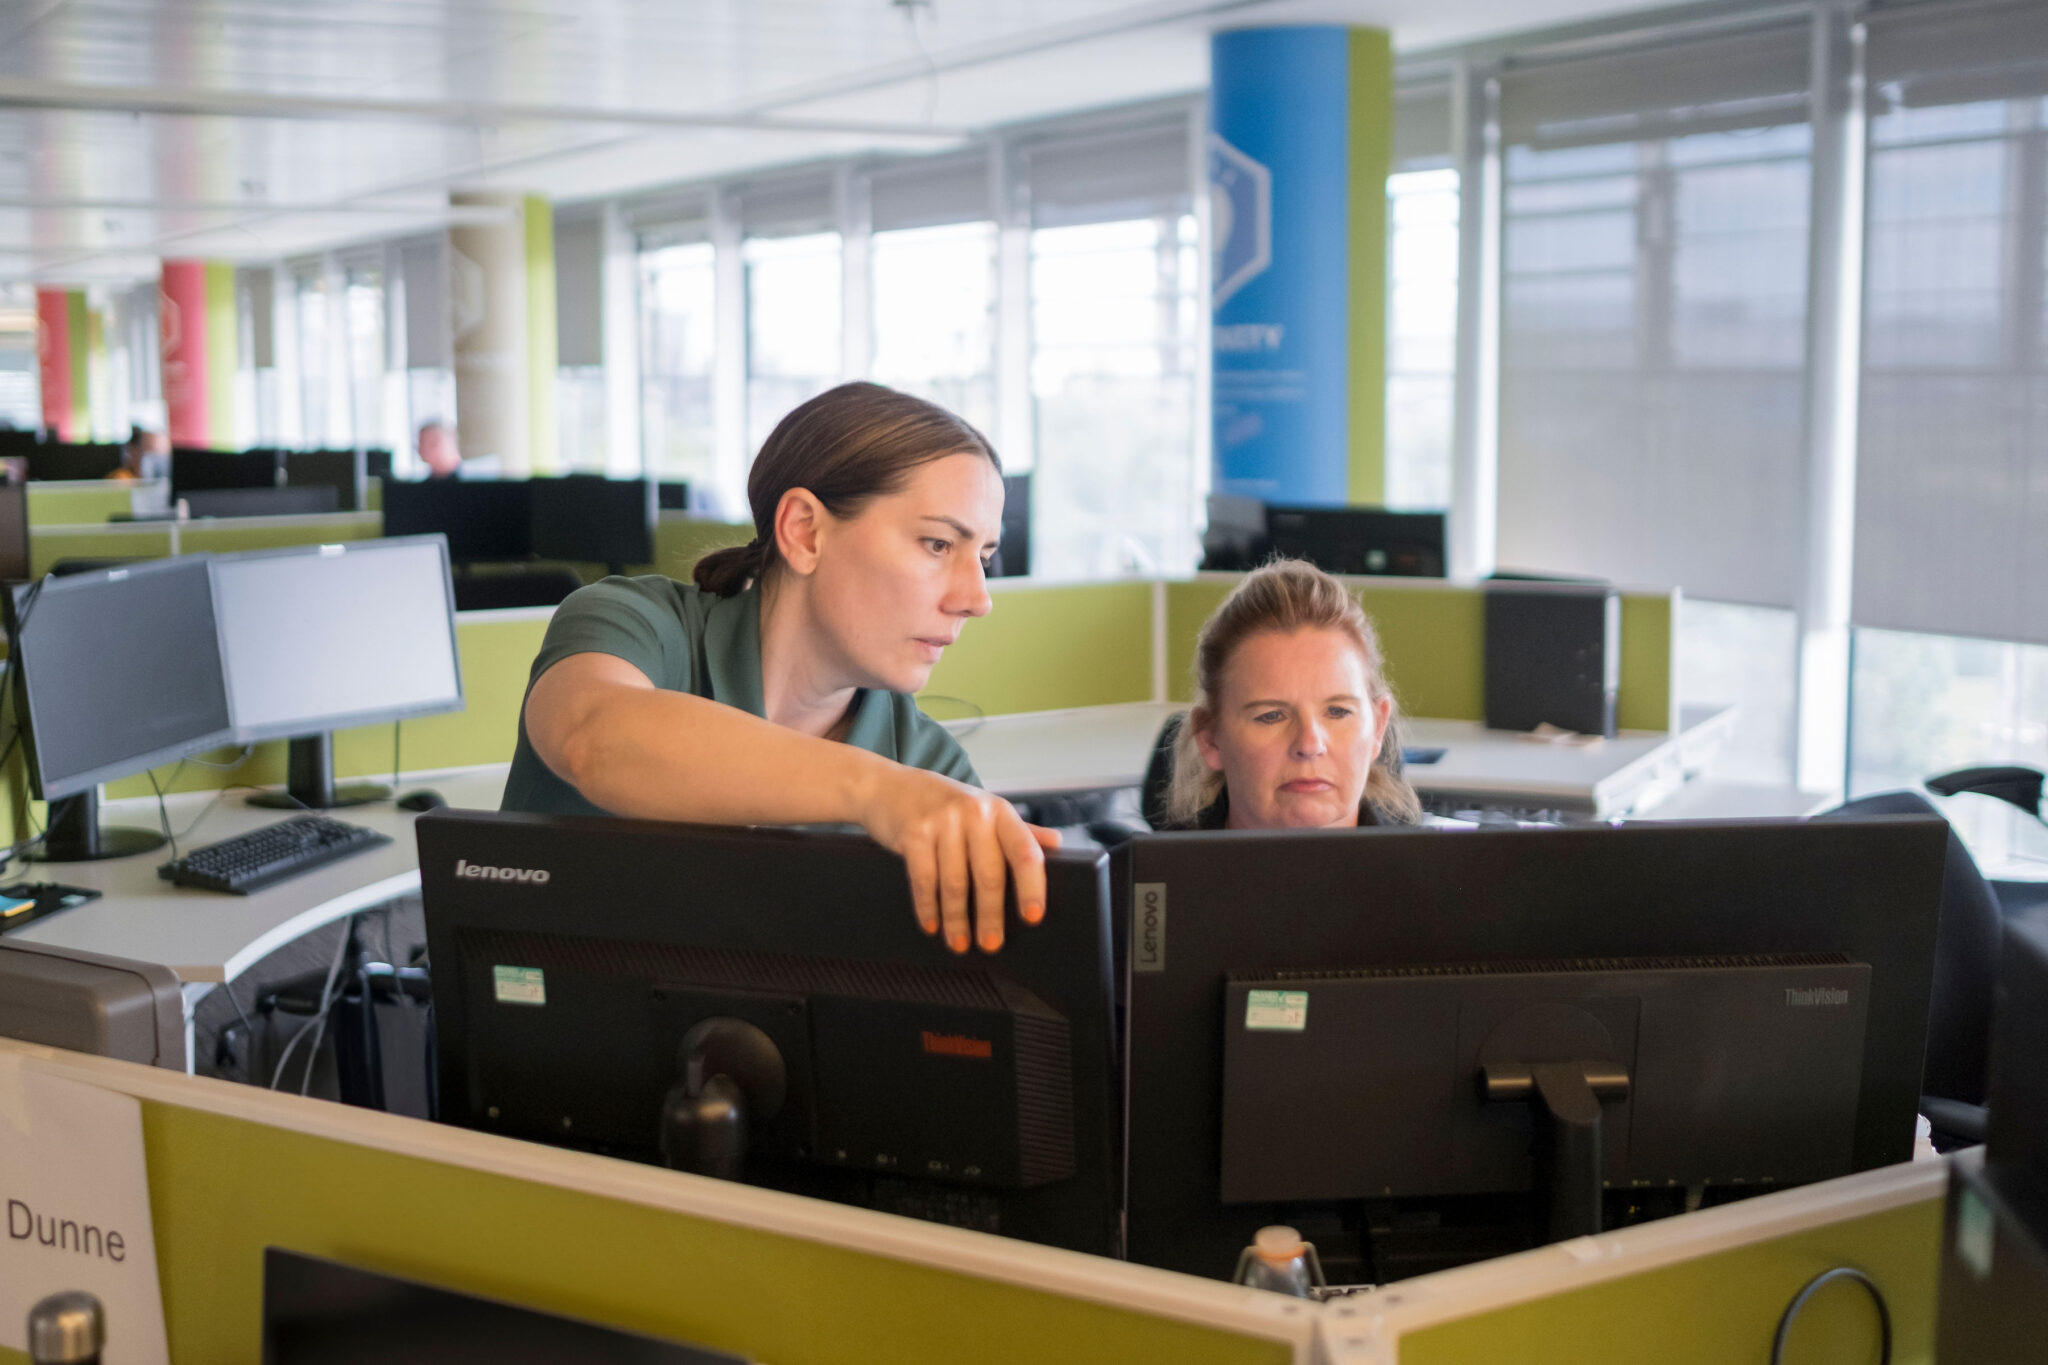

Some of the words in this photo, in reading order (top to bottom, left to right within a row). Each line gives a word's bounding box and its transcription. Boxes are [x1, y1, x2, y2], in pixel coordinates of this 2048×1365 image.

[456, 859, 551, 883] lenovo
[1141, 891, 1158, 963] Lenovo
[1784, 987, 1849, 1006] ThinkVision
[8, 1199, 125, 1262] Dunne
